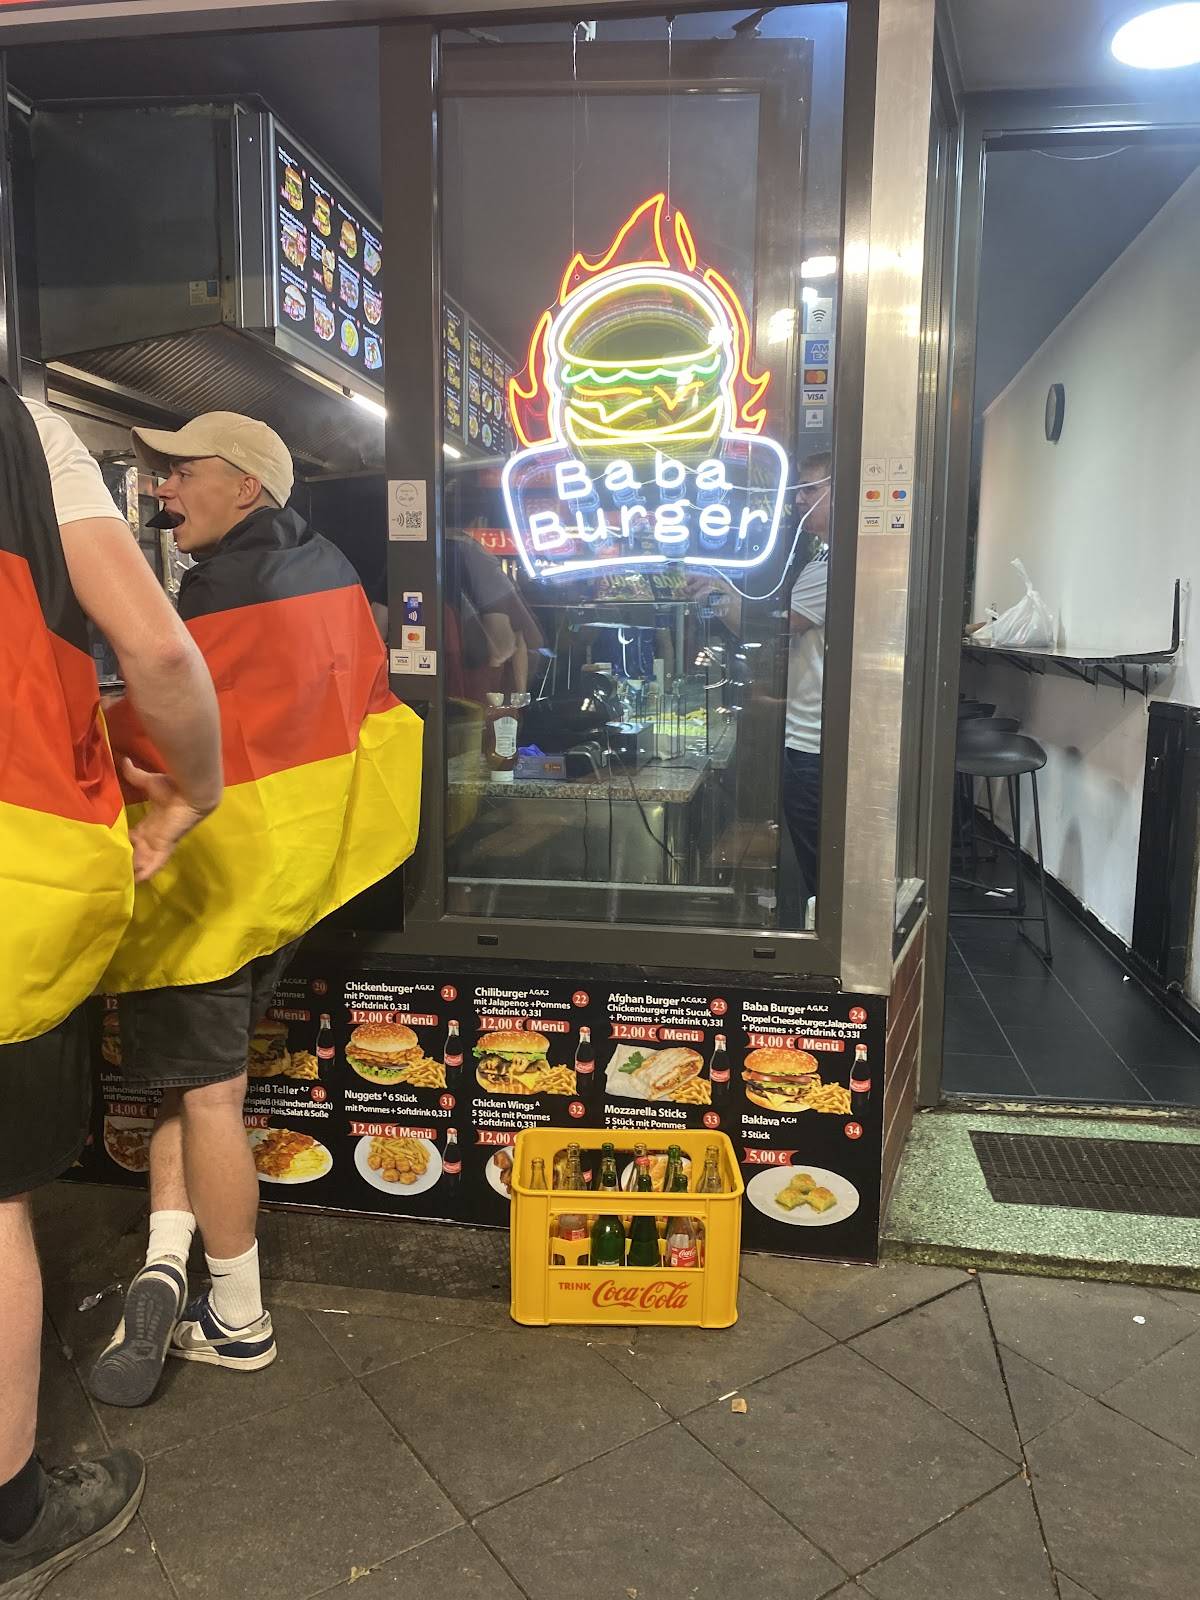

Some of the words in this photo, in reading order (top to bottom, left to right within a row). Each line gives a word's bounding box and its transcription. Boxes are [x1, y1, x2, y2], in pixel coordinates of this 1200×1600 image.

[811, 344, 829, 353] AM
[555, 451, 733, 500] Baba
[528, 499, 768, 551] Burger
[345, 982, 414, 995] Chickenburger
[443, 989, 454, 998] 21
[474, 987, 528, 1000] Chiliburger
[344, 992, 358, 1000] mit
[359, 993, 393, 1002] Pommes
[473, 998, 488, 1006] mit
[488, 998, 529, 1008] Jalapenos
[575, 995, 587, 1004] 22
[608, 993, 644, 1005] Afghan
[645, 995, 680, 1008] Burger
[351, 1001, 389, 1010] Softdrink
[389, 1003, 410, 1011] 0,33l
[481, 1007, 520, 1016] Softdrink
[521, 1009, 542, 1017] 0,33l
[607, 1004, 669, 1015] Chickenburger
[669, 1008, 685, 1016] mit
[685, 1008, 712, 1018] Sucuk
[713, 1002, 725, 1011] 23
[742, 1001, 769, 1012] Baba
[770, 1003, 806, 1016] Burger
[273, 1009, 306, 1021] Menü
[352, 1011, 383, 1024] 12,00
[385, 1013, 394, 1024] €
[400, 1014, 434, 1026] Menü
[616, 1013, 652, 1023] Pommes
[660, 1016, 701, 1026] Softdrink
[701, 1019, 724, 1027] 0,33l
[741, 1014, 771, 1025] Doppel
[851, 1010, 865, 1020] 24
[481, 1018, 513, 1030] 12,00
[514, 1019, 524, 1030] €
[530, 1020, 565, 1033] Menü
[749, 1024, 787, 1034] Pommes
[795, 1027, 837, 1038] Softdrink
[838, 1030, 860, 1039] 0,33l
[613, 1026, 645, 1039] 12,00
[648, 1027, 657, 1039] €
[663, 1029, 699, 1041] Menü
[750, 1035, 783, 1049] 14,00
[786, 1037, 795, 1049] €
[803, 1038, 839, 1052] Menü
[272, 1085, 299, 1095] Teller
[312, 1089, 324, 1098] 30
[344, 1089, 382, 1102] Nuggets
[388, 1093, 394, 1101] 6
[395, 1094, 418, 1103] Stück
[271, 1098, 334, 1111] (Hähnchenfleisch)
[441, 1097, 453, 1107] 31
[472, 1098, 507, 1109] Chicken
[507, 1100, 535, 1112] Wings
[310, 1110, 329, 1119] Soße
[344, 1104, 358, 1112] mit
[358, 1104, 390, 1114] Pommes
[396, 1107, 431, 1117] Softdrink
[471, 1109, 477, 1117] 5
[478, 1110, 501, 1119] Stück
[501, 1111, 515, 1119] mit
[516, 1112, 551, 1121] Pommes
[570, 1105, 583, 1114] 32
[604, 1104, 657, 1117] Mozzarella
[658, 1108, 687, 1119] Sticks
[260, 1117, 268, 1128] €
[478, 1118, 516, 1128] Softdrink
[604, 1117, 611, 1125] 5
[611, 1117, 635, 1127] Stück
[635, 1119, 650, 1127] mit
[650, 1120, 687, 1130] Pommes
[705, 1115, 718, 1125] 33
[741, 1114, 780, 1126] Baklava
[352, 1123, 382, 1136] 12,00
[384, 1125, 393, 1136] €
[399, 1127, 432, 1139] Menü
[747, 1131, 771, 1140] Stück
[847, 1125, 861, 1136] 34
[480, 1132, 511, 1145] 12,00
[749, 1150, 776, 1164] 5,00
[778, 1152, 787, 1164] €
[558, 1282, 591, 1291] TRINK
[592, 1279, 693, 1309] Coca-Cola
